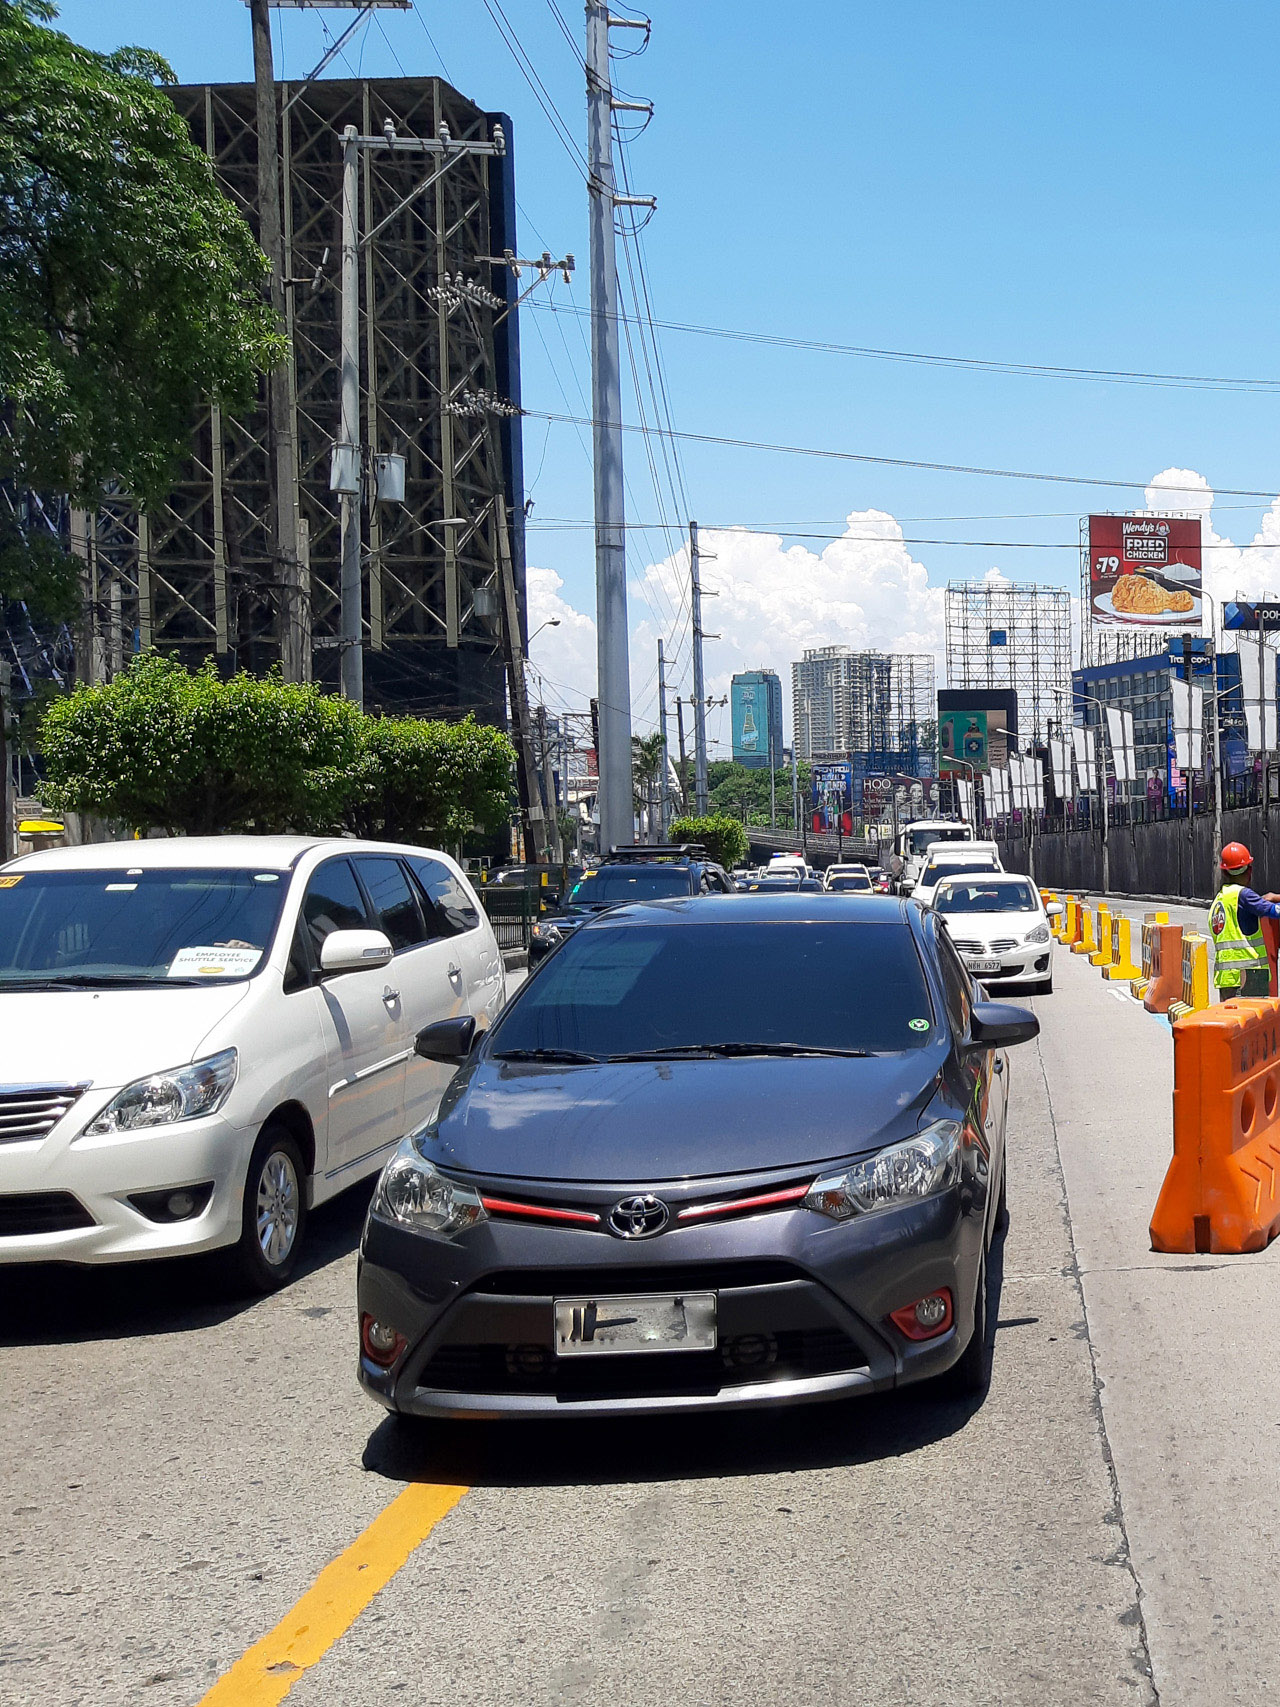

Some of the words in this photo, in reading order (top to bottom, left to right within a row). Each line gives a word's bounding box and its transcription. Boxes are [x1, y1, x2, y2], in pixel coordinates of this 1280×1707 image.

[1122, 520, 1155, 536] Wendy's
[1126, 538, 1165, 552] FRIED
[1126, 551, 1165, 560] CHICKEN
